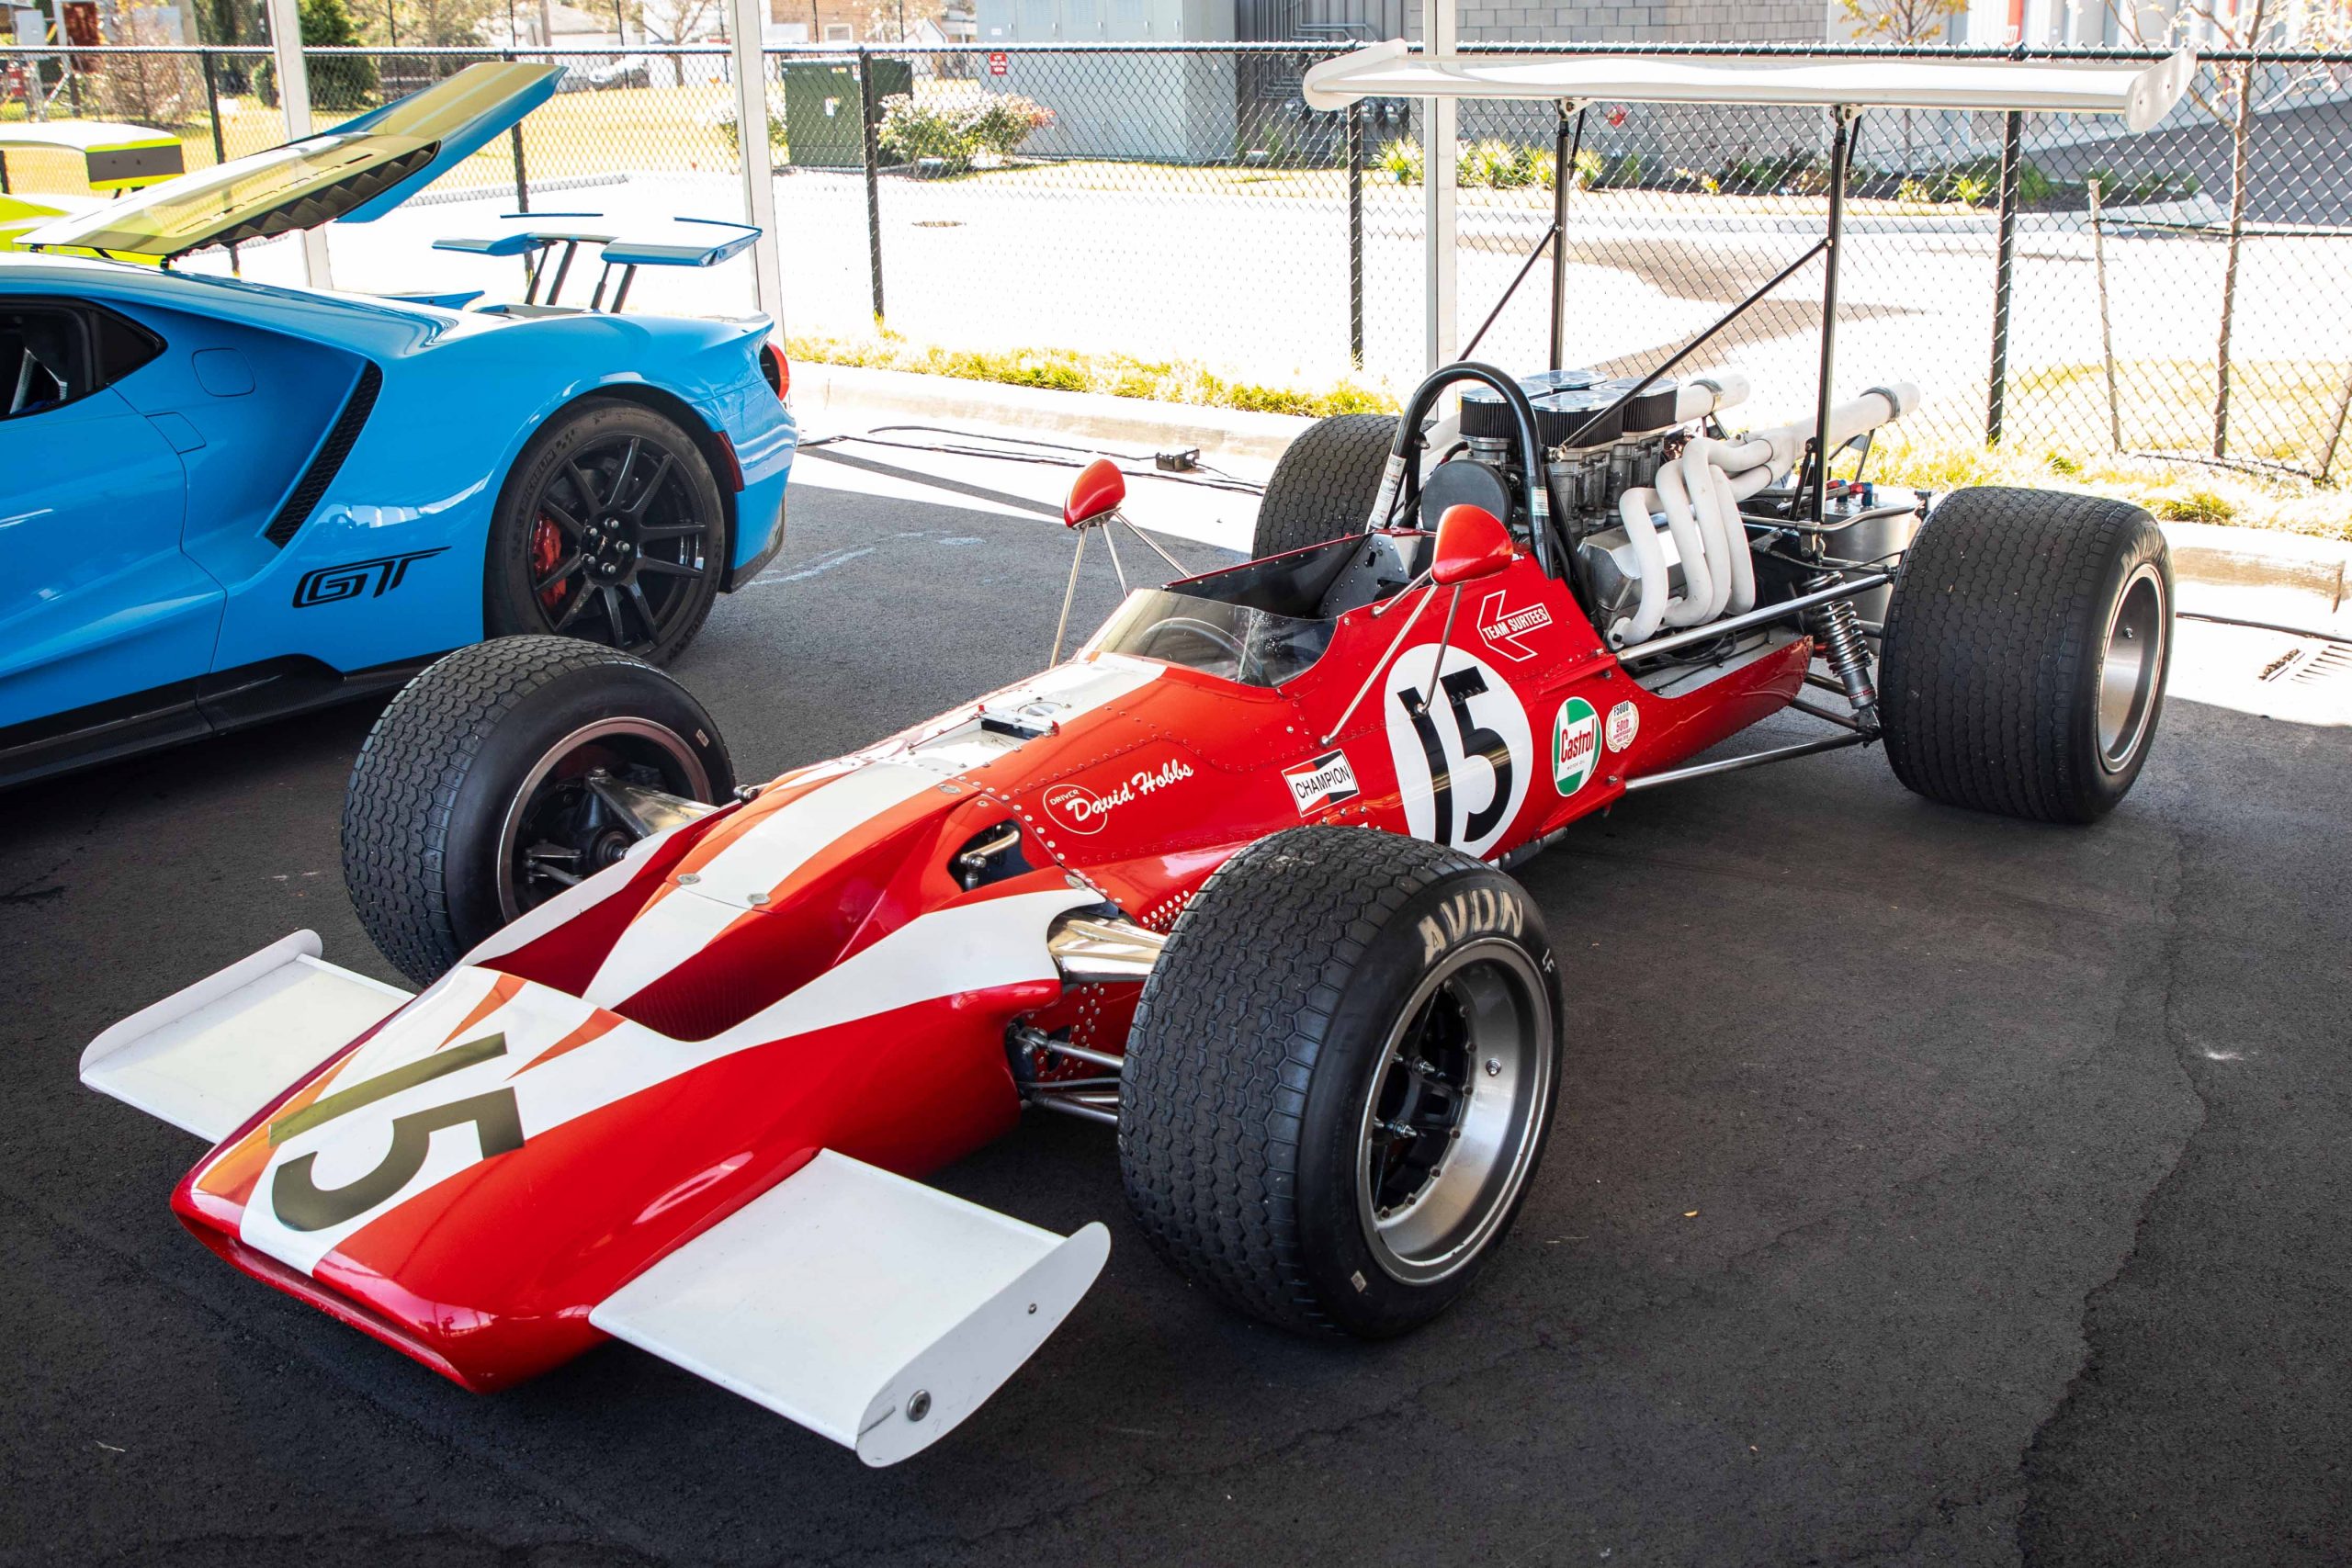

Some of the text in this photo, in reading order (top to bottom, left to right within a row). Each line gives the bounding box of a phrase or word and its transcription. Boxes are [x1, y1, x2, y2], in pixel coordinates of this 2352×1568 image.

[292, 545, 452, 608] GT
[1482, 608, 1548, 640] TEAM SURTEES
[1397, 666, 1512, 847] 15
[1561, 718, 1595, 763] Castrol
[1049, 789, 1080, 806] DRIVER
[1065, 759, 1193, 822] David Hobbs
[1295, 765, 1351, 799] CHAMPION
[1418, 887, 1523, 968] AVON
[268, 1032, 525, 1232] 15
